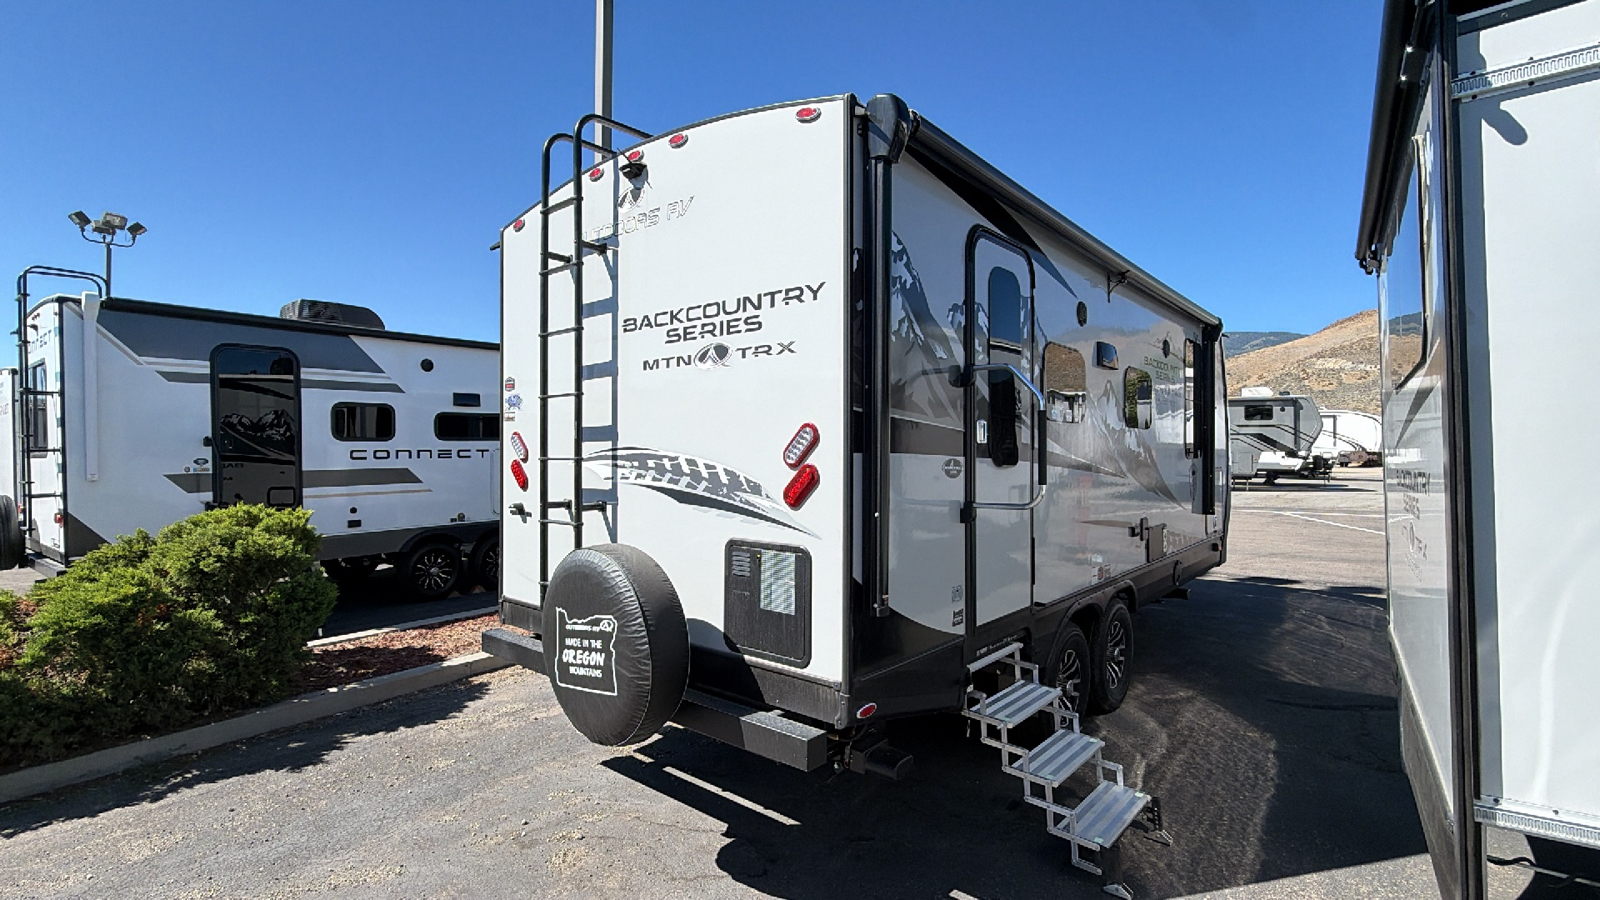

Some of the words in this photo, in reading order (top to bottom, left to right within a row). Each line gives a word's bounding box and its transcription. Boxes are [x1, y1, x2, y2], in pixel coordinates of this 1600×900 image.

[666, 195, 695, 221] RV
[622, 281, 826, 334] BACKCOUNTRY
[664, 314, 763, 344] SERIES
[642, 354, 693, 371] MTN
[735, 340, 797, 359] TRX
[349, 449, 490, 461] CONNECT
[565, 637, 581, 648] MADE
[582, 639, 589, 648] IN
[590, 639, 603, 649] THE
[562, 648, 605, 666] OREGON
[569, 666, 602, 677] MOUNTAINS
